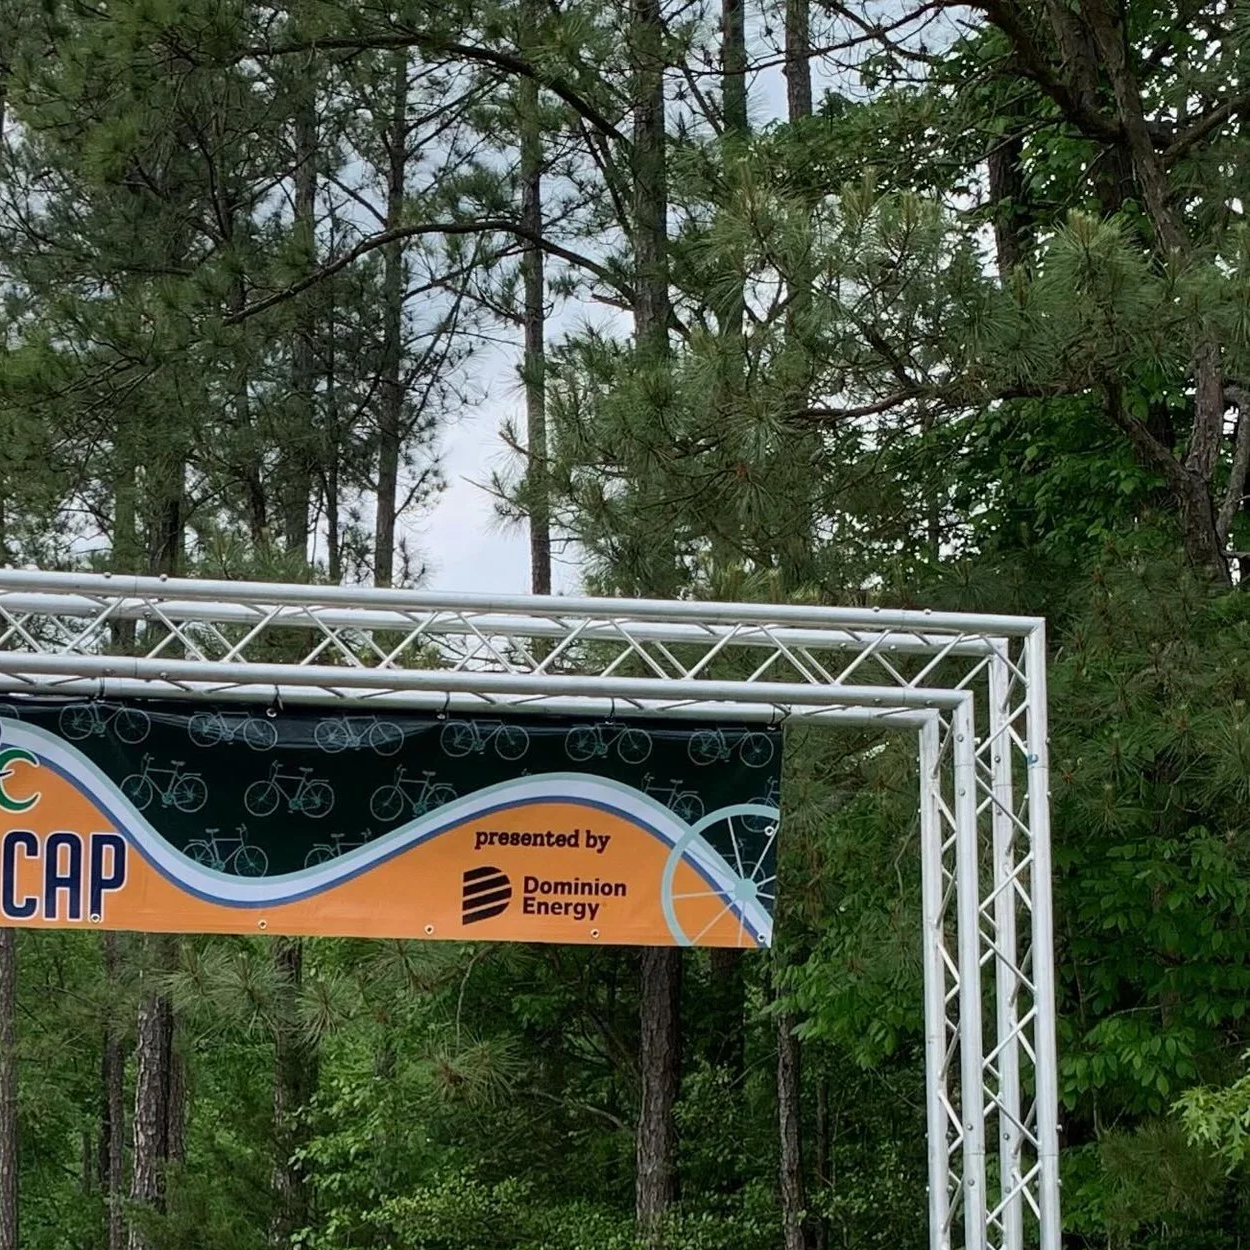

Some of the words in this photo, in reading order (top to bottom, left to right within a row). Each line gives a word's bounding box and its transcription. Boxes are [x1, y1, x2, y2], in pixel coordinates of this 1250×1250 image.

[475, 829, 580, 850] presented
[585, 829, 611, 853] by
[523, 876, 627, 897] Dominion
[523, 896, 600, 921] Energy
